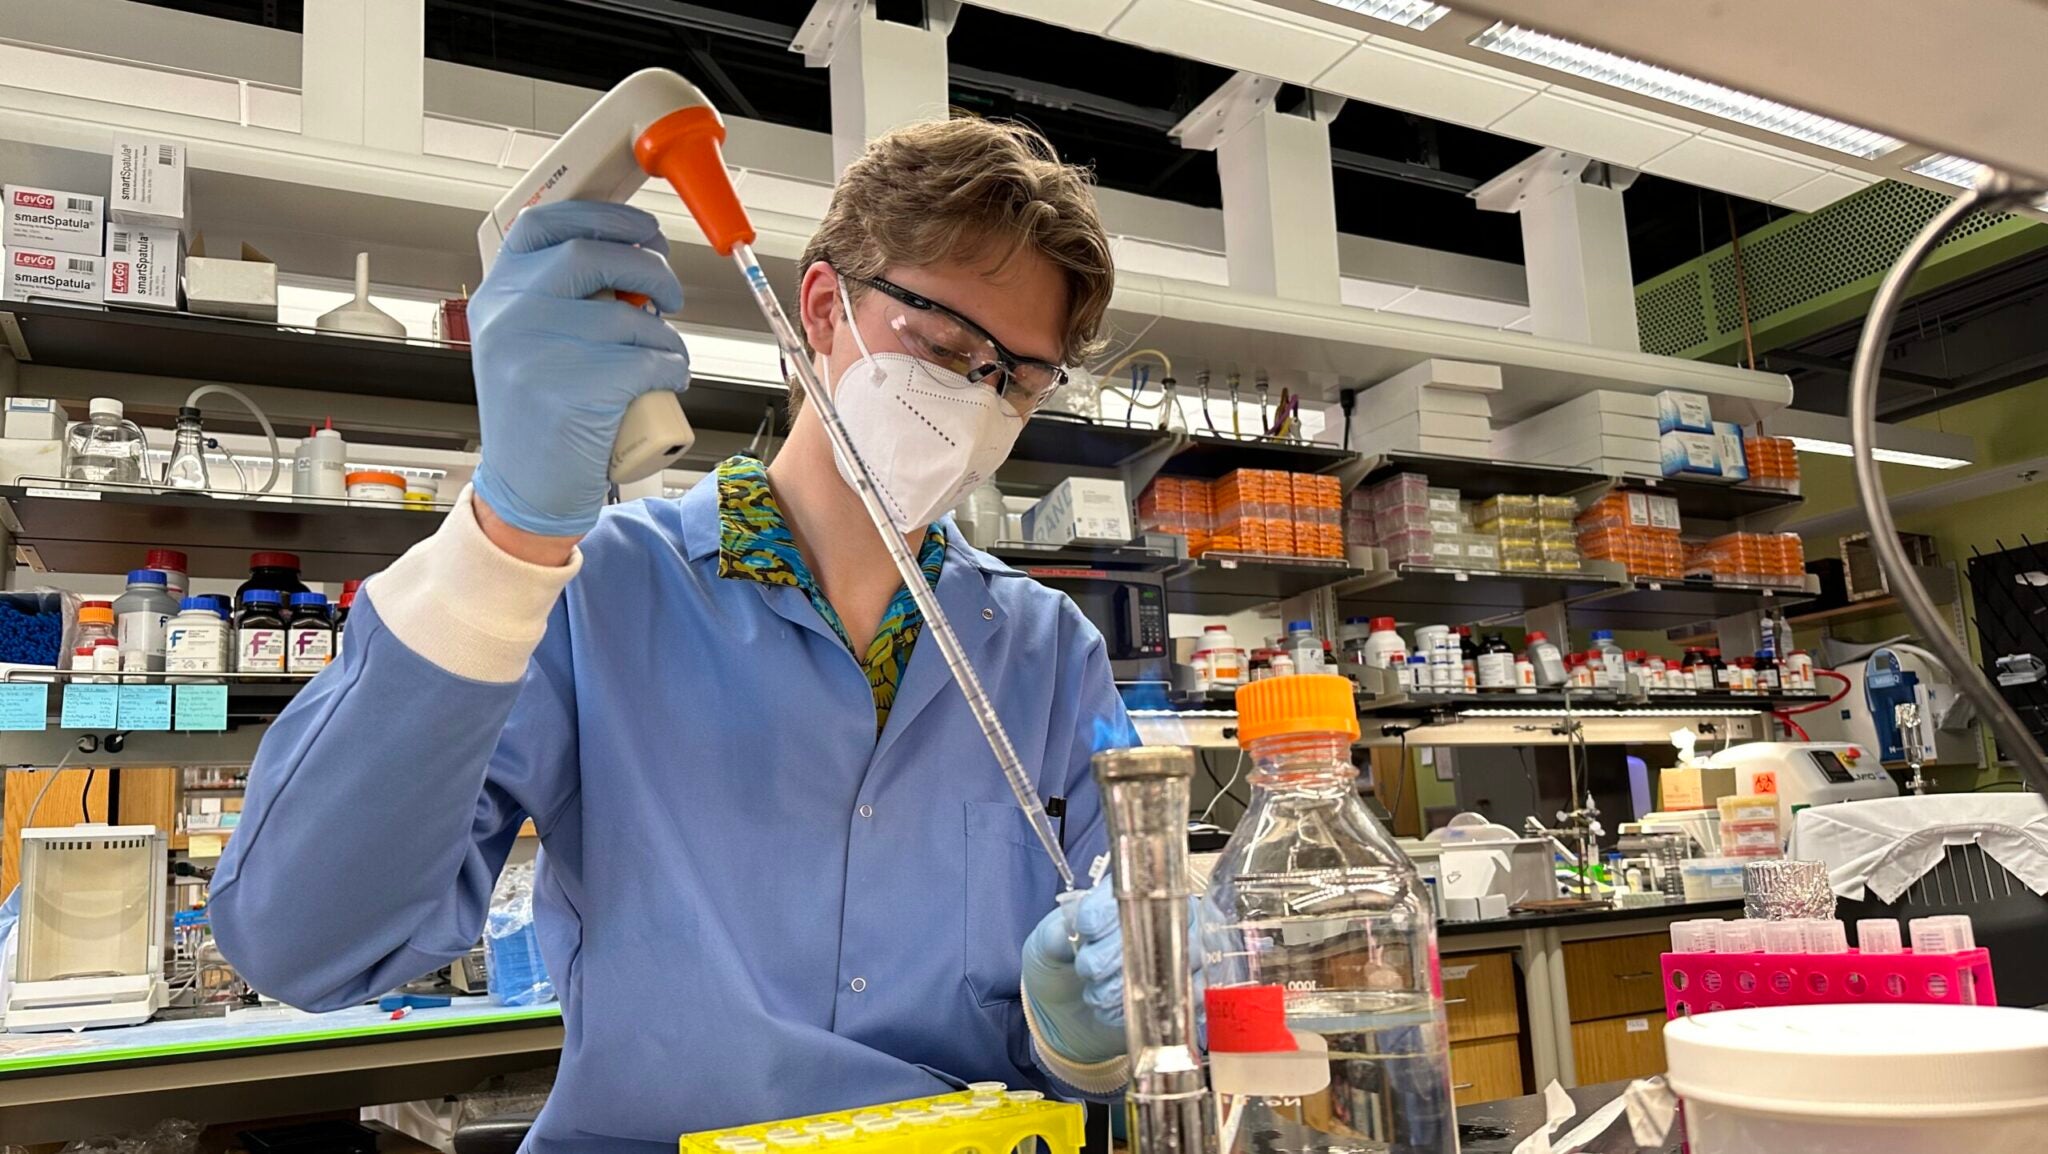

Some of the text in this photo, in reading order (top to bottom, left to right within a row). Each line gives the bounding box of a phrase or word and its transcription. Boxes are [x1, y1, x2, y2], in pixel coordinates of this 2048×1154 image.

[545, 164, 568, 189] ULTRA
[15, 192, 53, 206] LevGo
[16, 253, 55, 267] LevGo
[112, 263, 125, 293] LevGo
